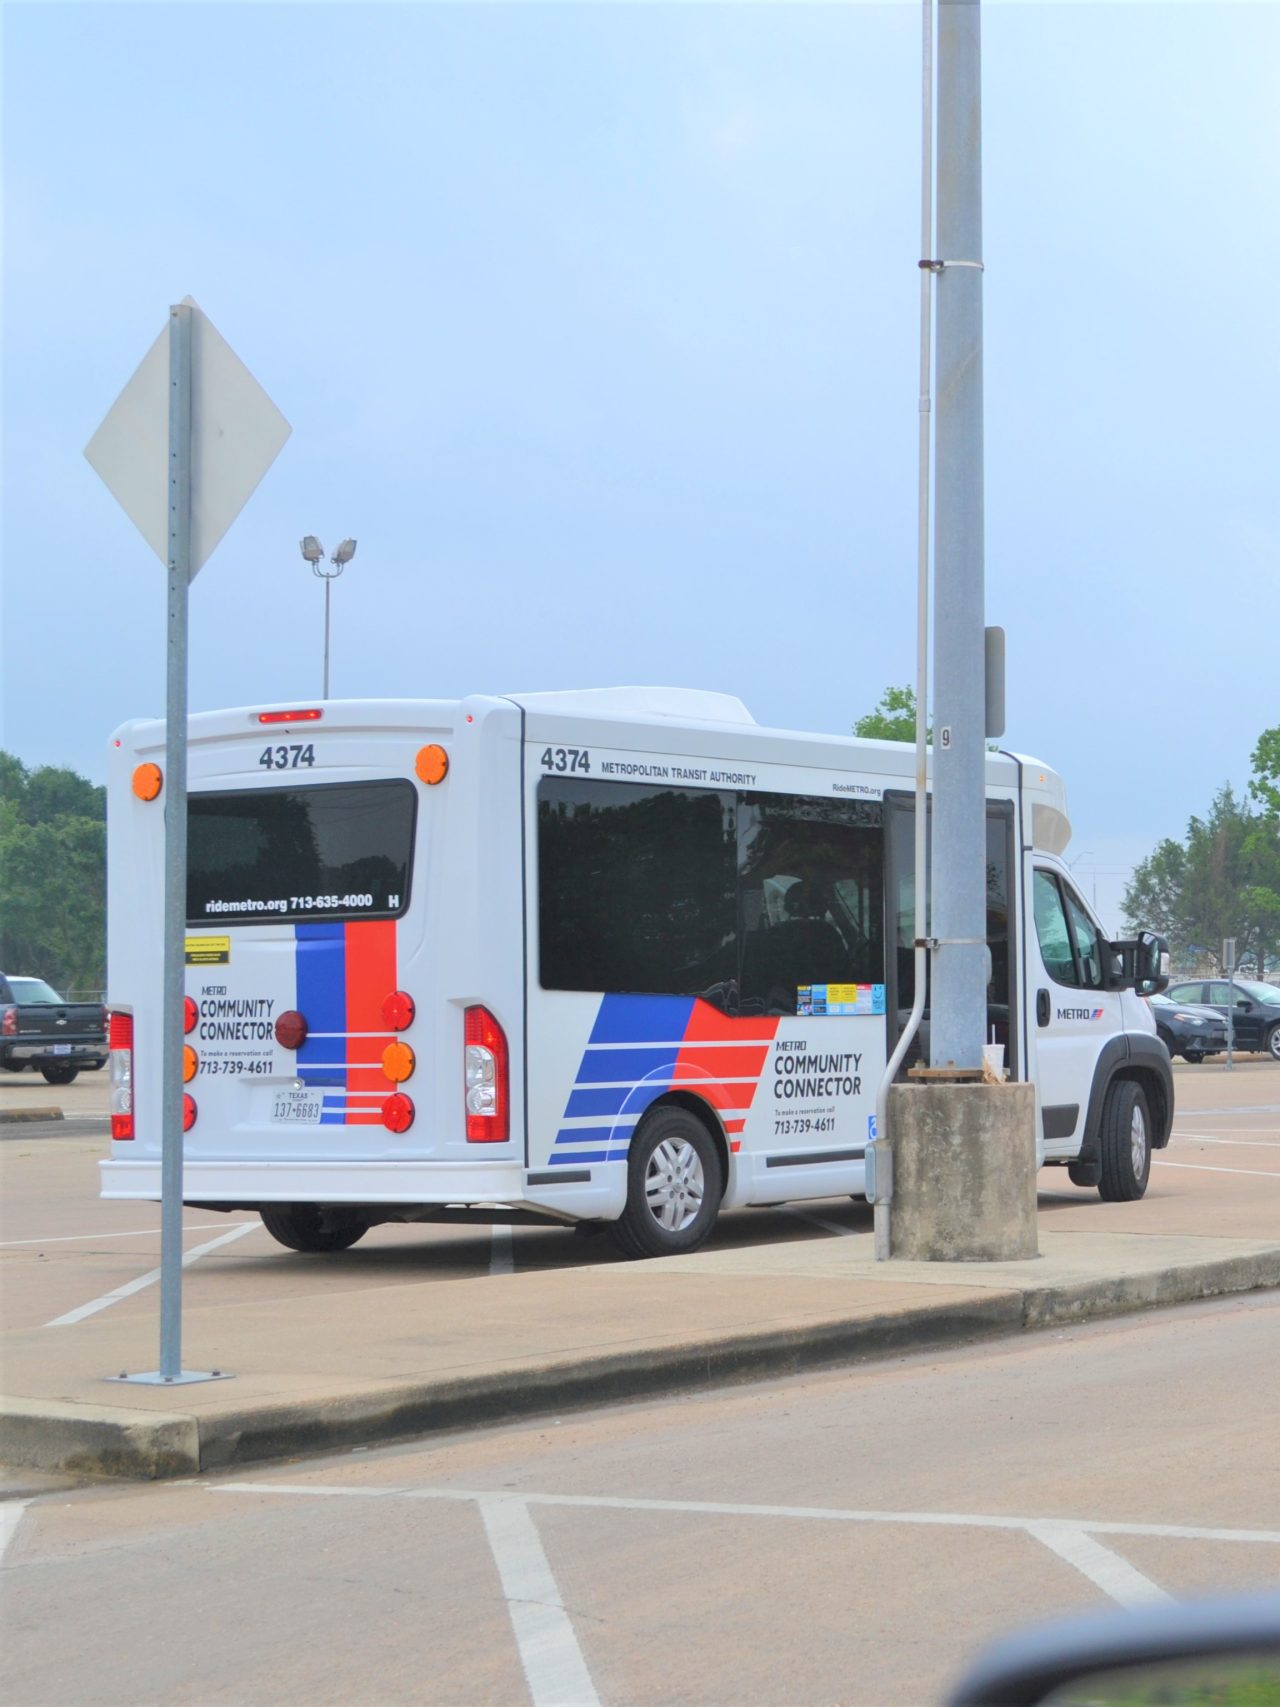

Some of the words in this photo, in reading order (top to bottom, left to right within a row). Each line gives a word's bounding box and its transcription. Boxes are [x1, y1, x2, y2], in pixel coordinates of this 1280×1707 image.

[942, 729, 950, 746] 9
[259, 744, 315, 769] 4374
[541, 747, 590, 773] 4374
[601, 762, 669, 778] METROPOLITAN
[671, 767, 707, 781] TRANSIT
[710, 771, 757, 785] AUTHORITY
[832, 783, 881, 797] RideMETRO.org
[205, 899, 287, 913] ridemetro.org
[290, 894, 373, 909] 713-635-4000
[388, 895, 399, 908] H
[201, 986, 227, 996] METRO
[200, 999, 274, 1018] COMMUNITY
[1057, 1008, 1090, 1020] METRO
[200, 1022, 273, 1040] CONNECTOR
[776, 1041, 807, 1051] METRO
[200, 1061, 273, 1074] 713-739-4611
[774, 1054, 862, 1075] COMMUNITY
[774, 1077, 861, 1099] CONNECTOR
[781, 1108, 794, 1116] make
[799, 1107, 826, 1115] reservation
[774, 1118, 835, 1135] 713-739-4611
